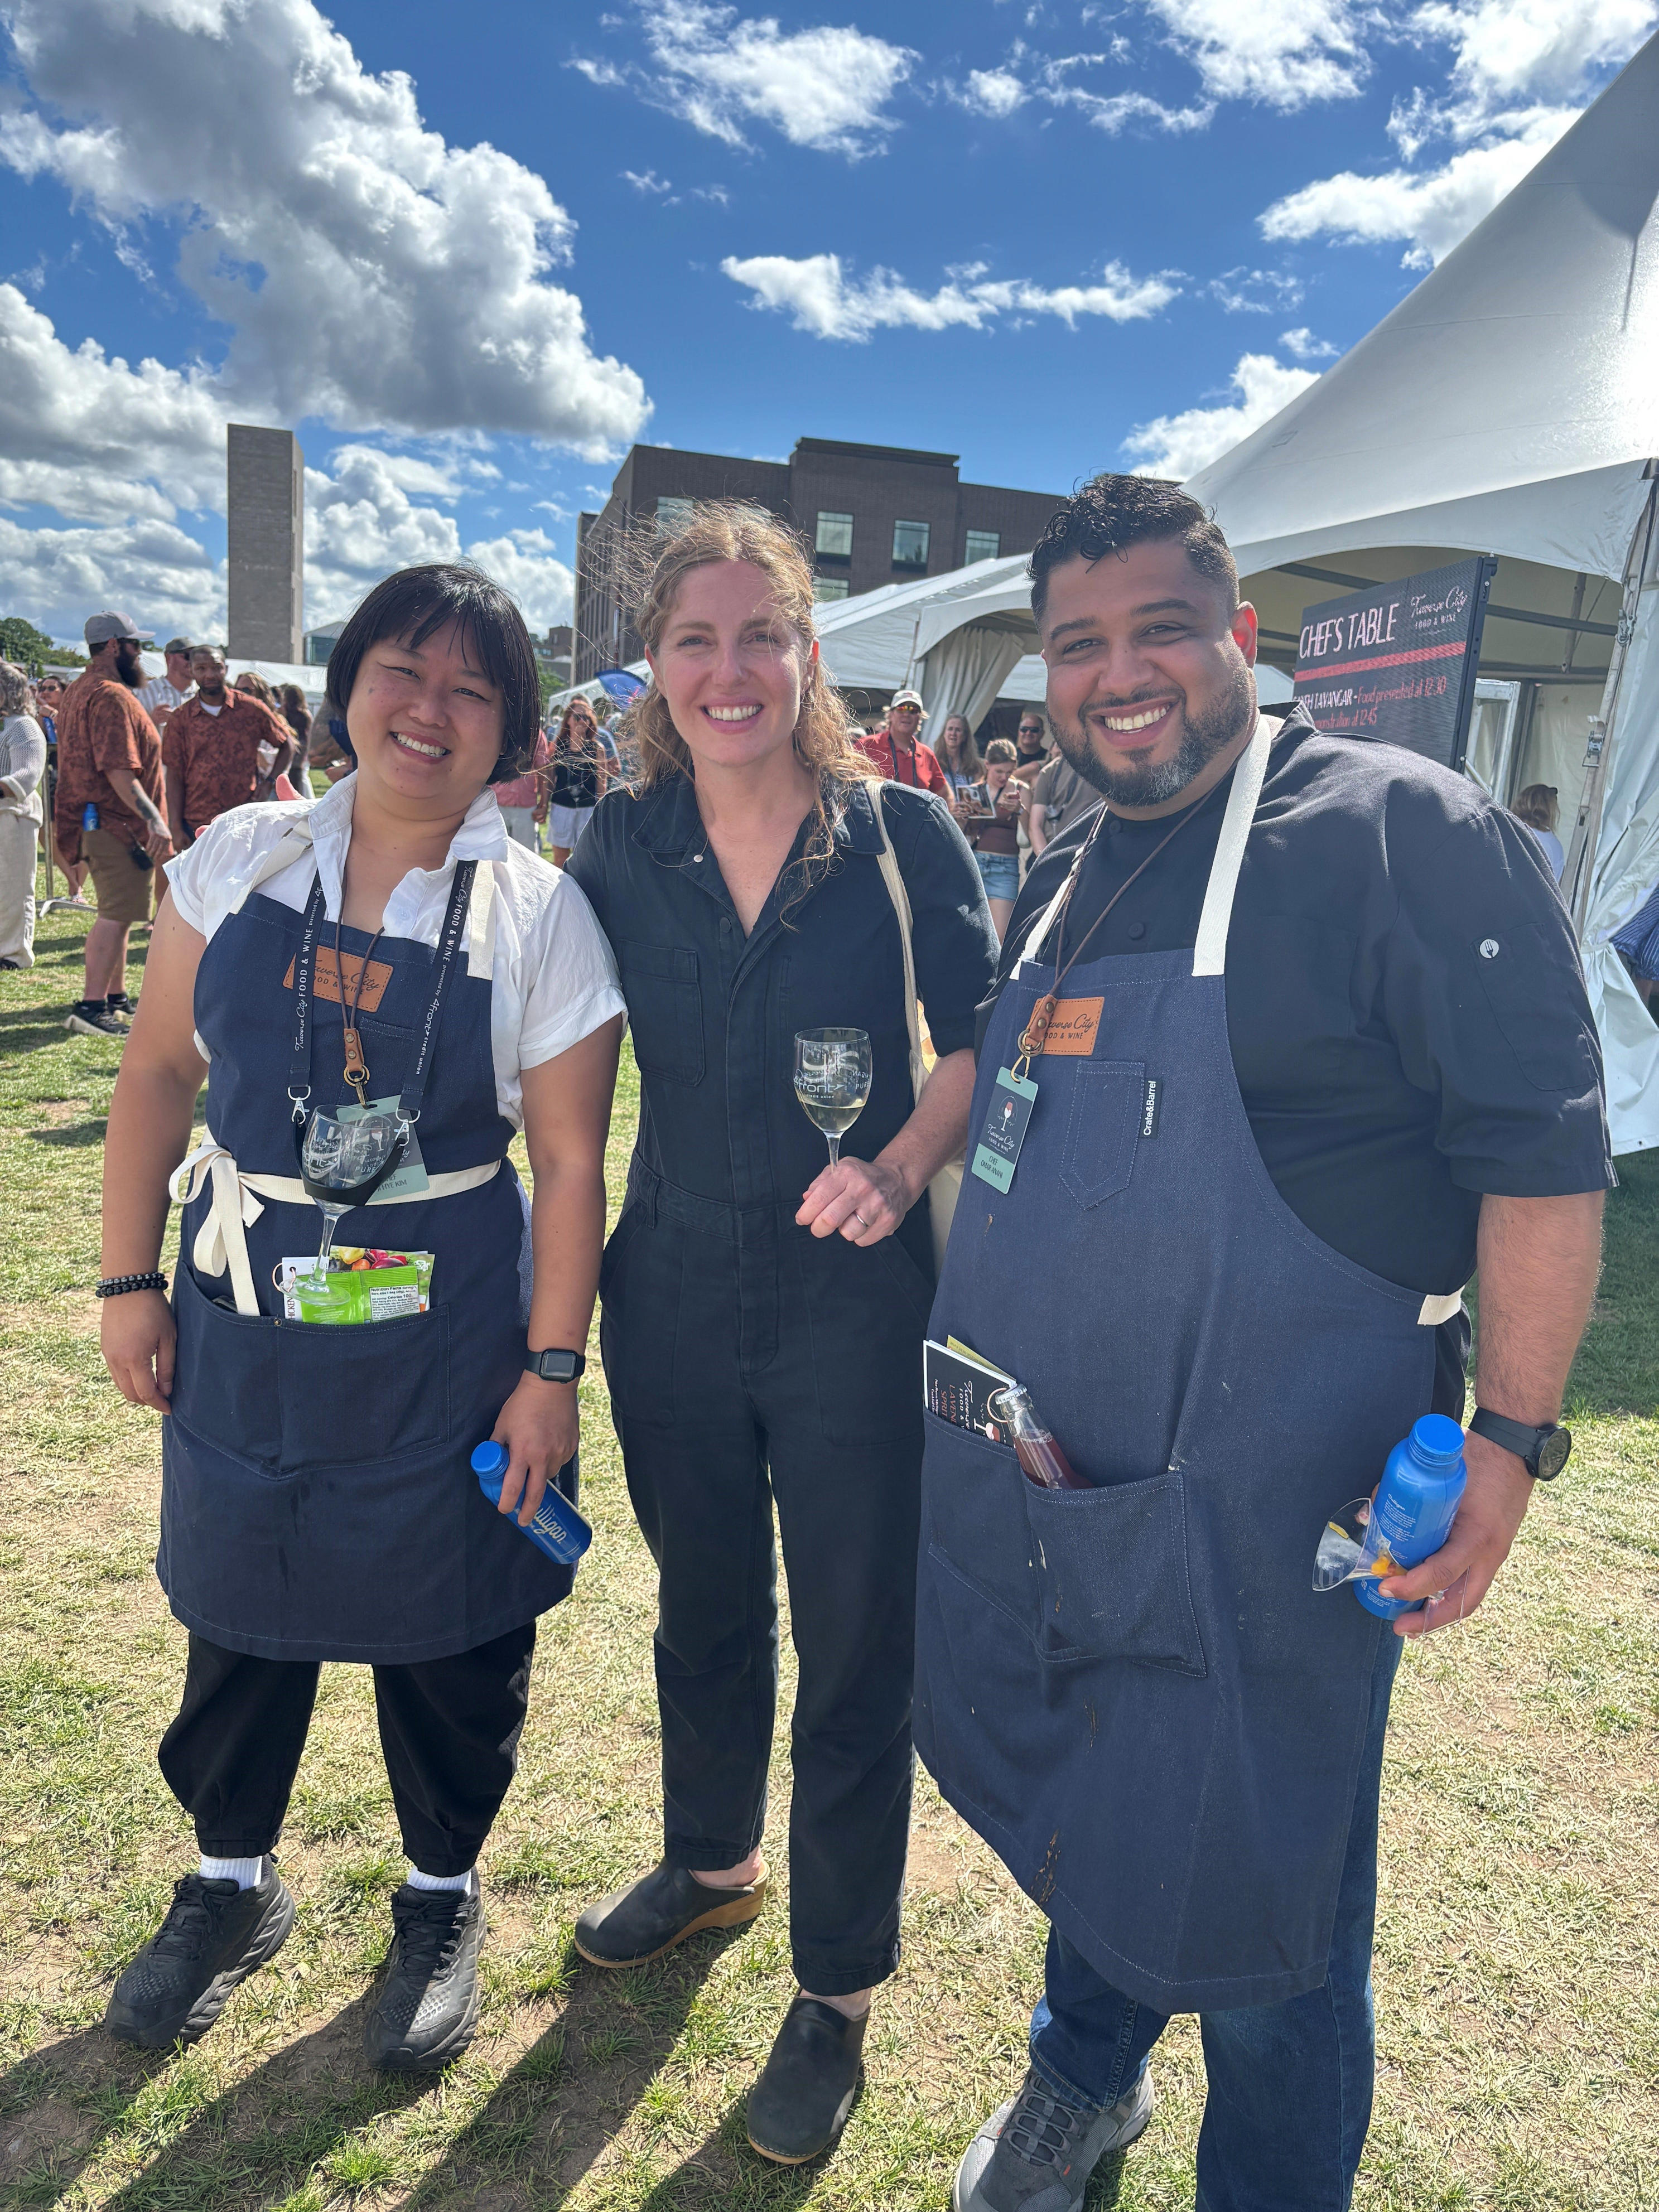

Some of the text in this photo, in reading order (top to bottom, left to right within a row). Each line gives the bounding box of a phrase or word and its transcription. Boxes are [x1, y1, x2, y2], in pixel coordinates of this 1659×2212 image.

[1445, 586, 1468, 612] City
[1299, 603, 1400, 659] CHEF'S TABLE
[460, 866, 473, 888] Traverse
[455, 888, 467, 903] City
[309, 904, 317, 925] presented
[451, 904, 462, 926] FOOD
[302, 929, 313, 952] WINE
[443, 940, 455, 962] WINE
[299, 969, 307, 997] FOOD
[314, 975, 329, 984] OD
[438, 964, 447, 989] presented
[296, 999, 308, 1018] City
[1073, 1013, 1094, 1033] City
[295, 1018, 305, 1051] Traverse
[1143, 1080, 1156, 1136] Crate&Barrel
[396, 1179, 407, 1187] KIM
[964, 1380, 973, 1429] Traverse
[1388, 1494, 1405, 1511] Culligan
[533, 1504, 567, 1544] ulligan
